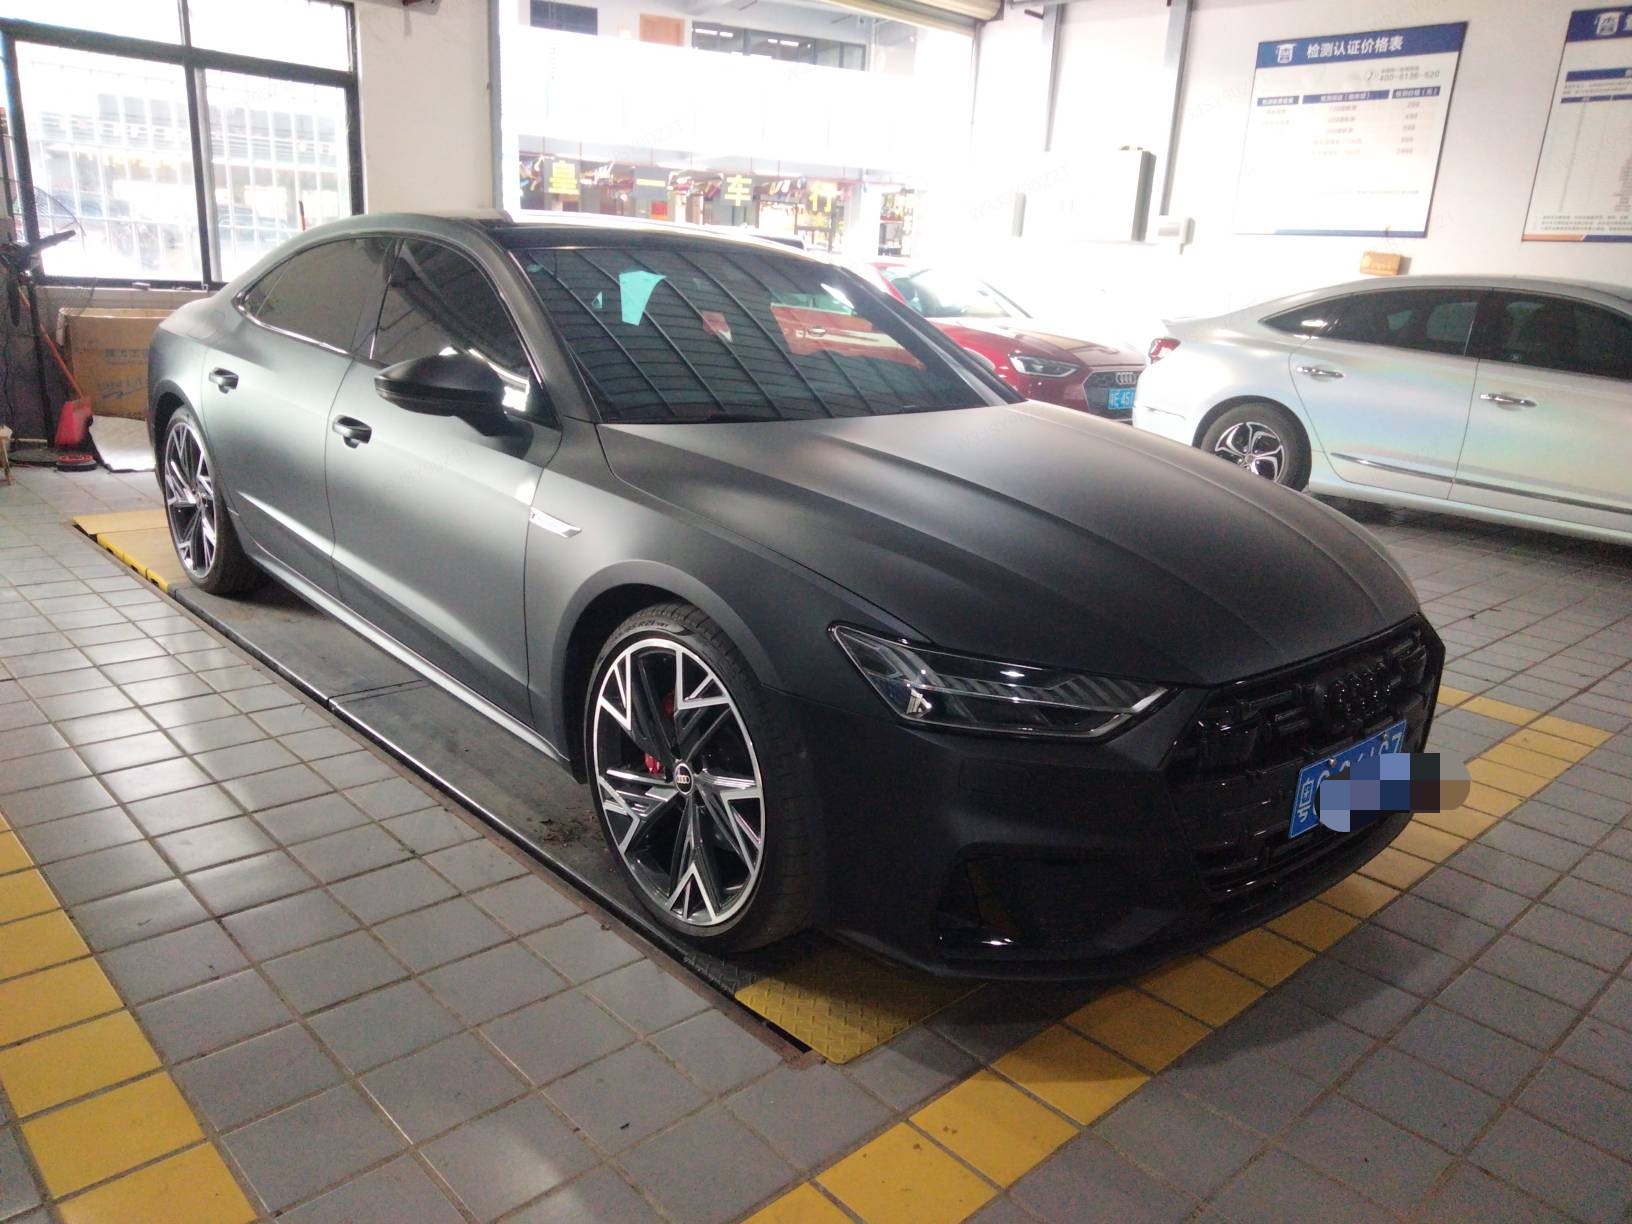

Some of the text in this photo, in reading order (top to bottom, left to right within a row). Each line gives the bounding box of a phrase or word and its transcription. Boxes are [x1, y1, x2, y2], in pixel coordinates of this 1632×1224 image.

[1307, 36, 1404, 58] 检测认证价格表
